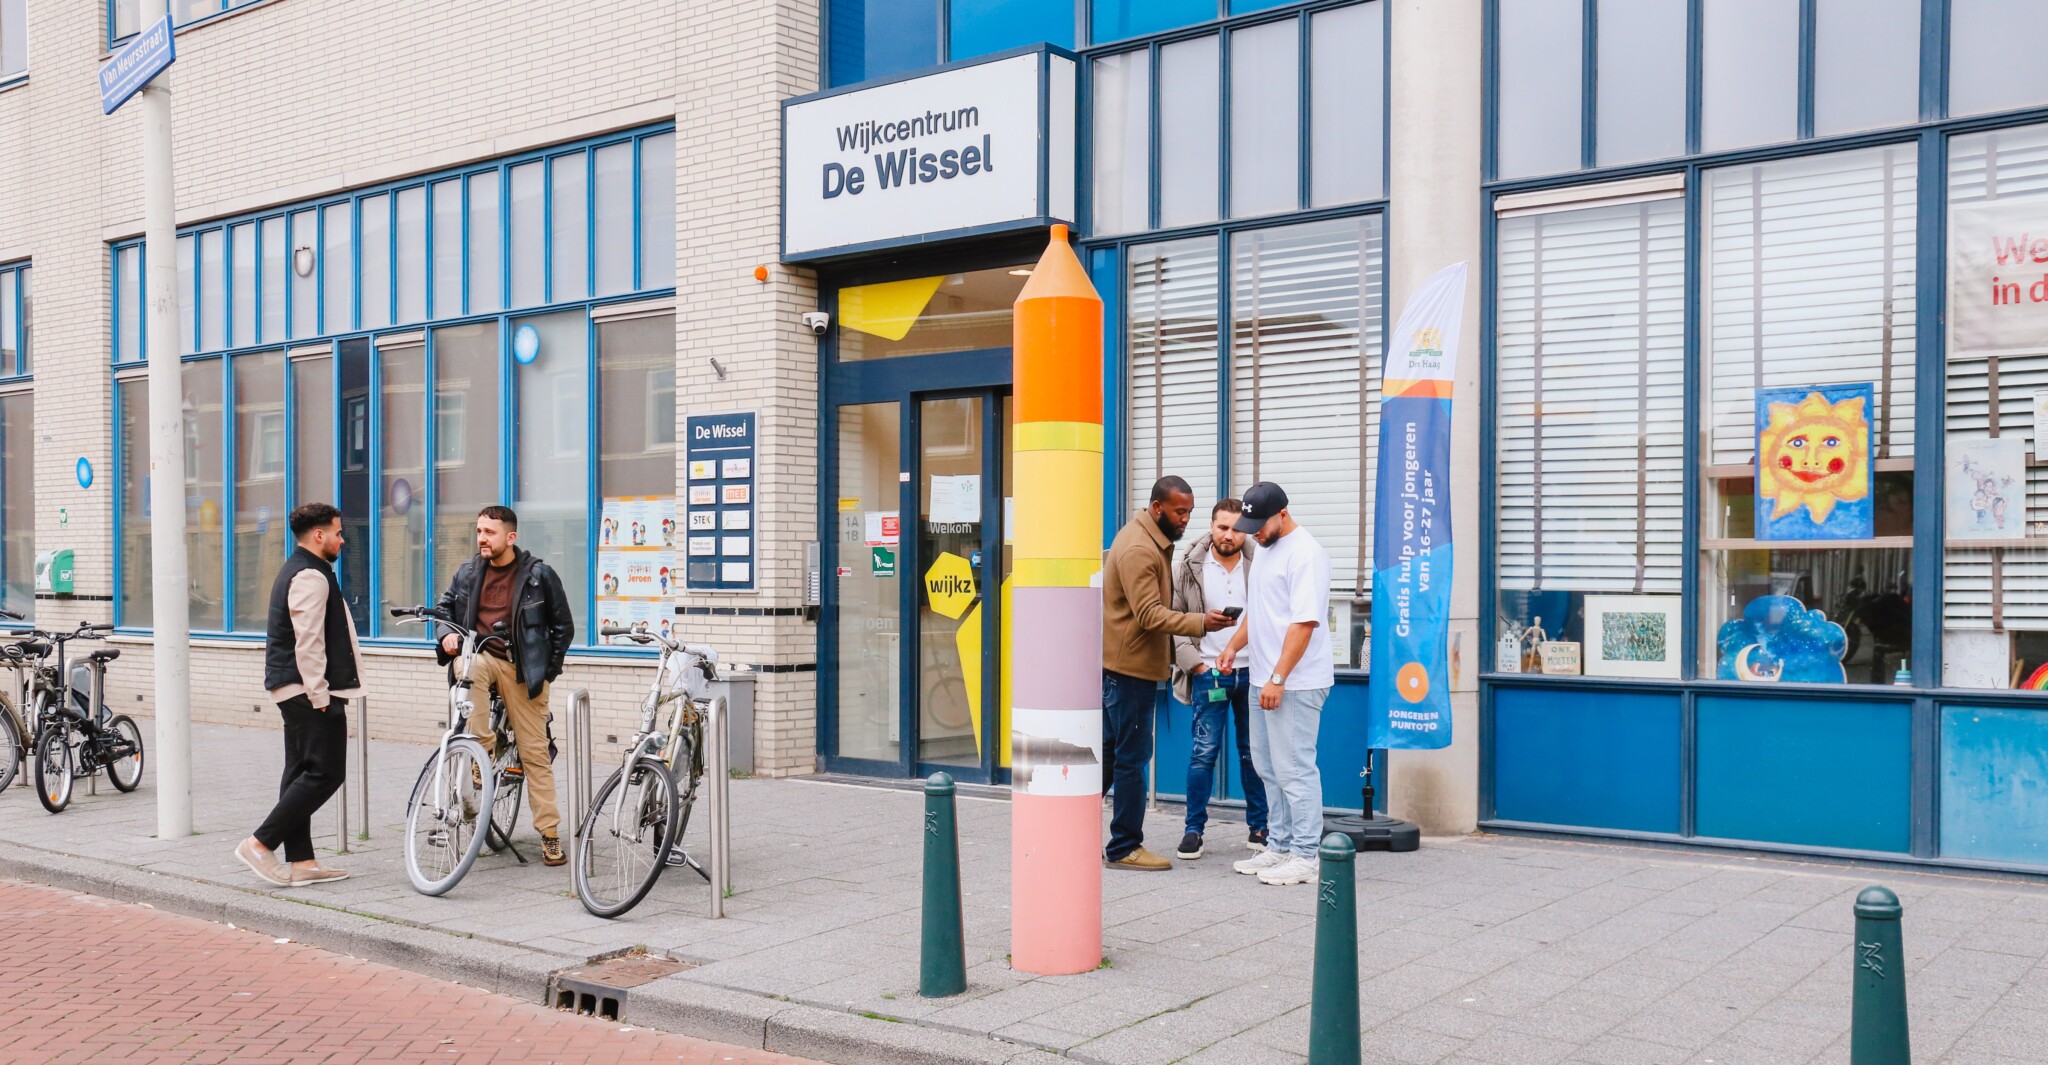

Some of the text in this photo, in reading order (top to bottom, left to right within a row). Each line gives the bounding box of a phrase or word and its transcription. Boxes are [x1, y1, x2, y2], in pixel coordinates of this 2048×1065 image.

[103, 67, 118, 87] Van
[117, 26, 163, 75] Meursstraat
[836, 106, 979, 153] Wijkcentrum
[822, 134, 993, 199] De Wissel
[1993, 276, 2020, 305] in
[695, 421, 747, 440] De Wissel
[845, 515, 859, 528] 1A
[930, 521, 972, 534] Welkom
[1396, 422, 1420, 638] Gratis hulp voor jongeren
[1419, 470, 1436, 593] van 16-27 jaar
[845, 530, 859, 542] 1B
[627, 574, 652, 583] Jeroen
[930, 575, 971, 598] wijkz
[1388, 710, 1439, 720] JONGEREN
